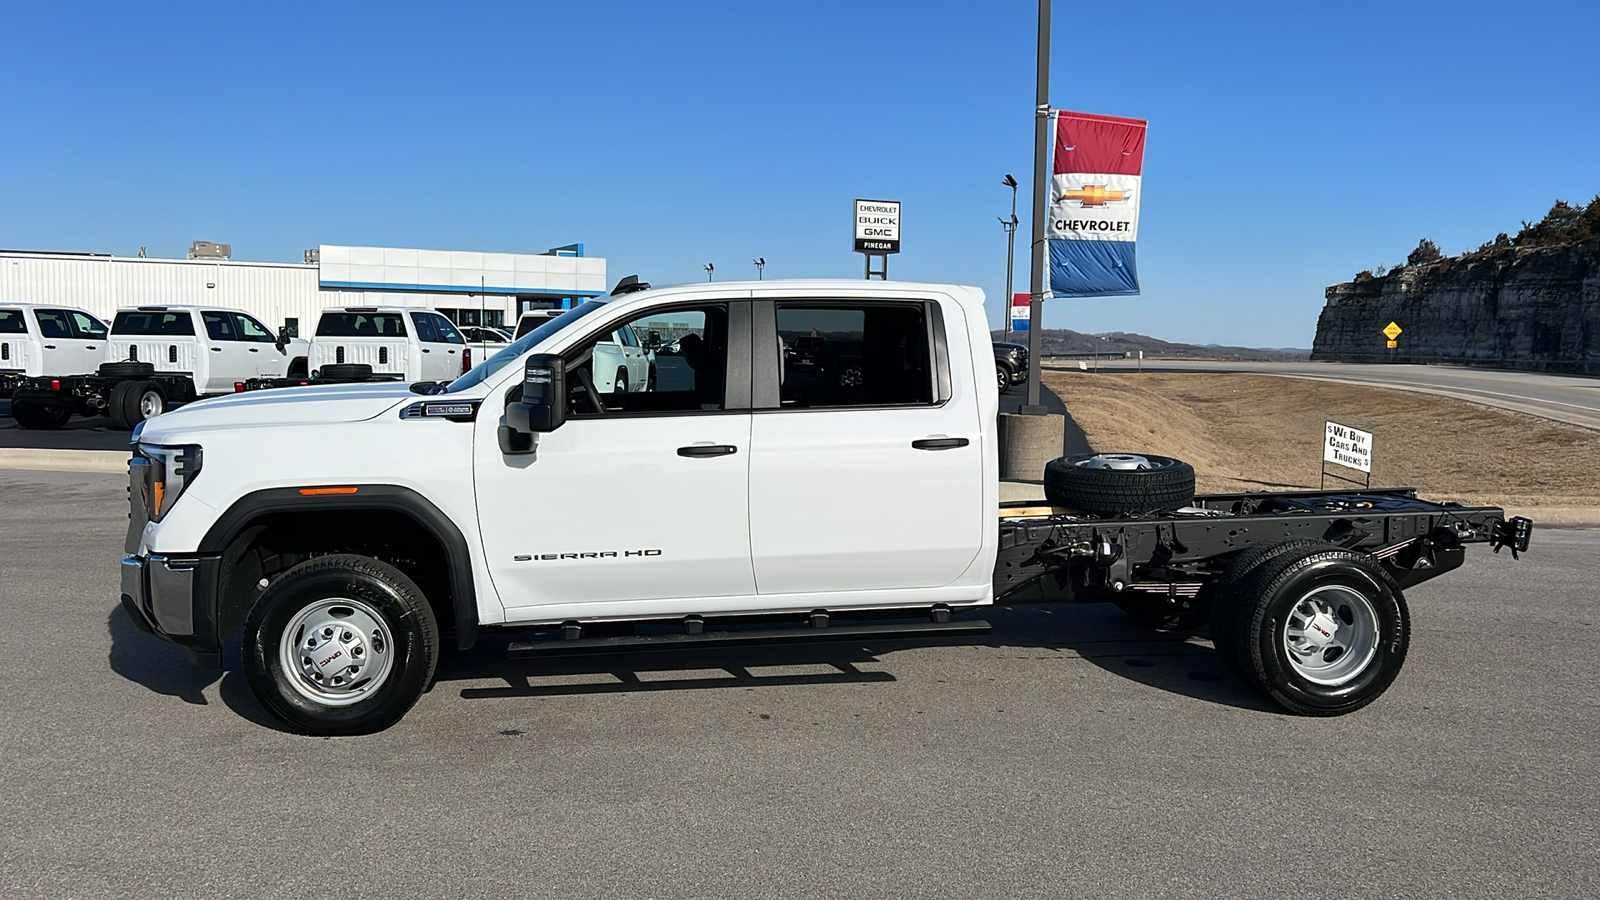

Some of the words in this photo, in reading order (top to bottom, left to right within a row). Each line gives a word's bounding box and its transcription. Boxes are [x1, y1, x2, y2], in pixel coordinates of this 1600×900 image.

[860, 205, 897, 213] CHEVROLET
[859, 216, 897, 225] BUICK
[1055, 220, 1130, 232] CHEVROLET
[864, 228, 892, 236] GMC
[864, 242, 892, 250] PINEGAR
[513, 551, 618, 562] SIERRA
[624, 549, 662, 558] HD
